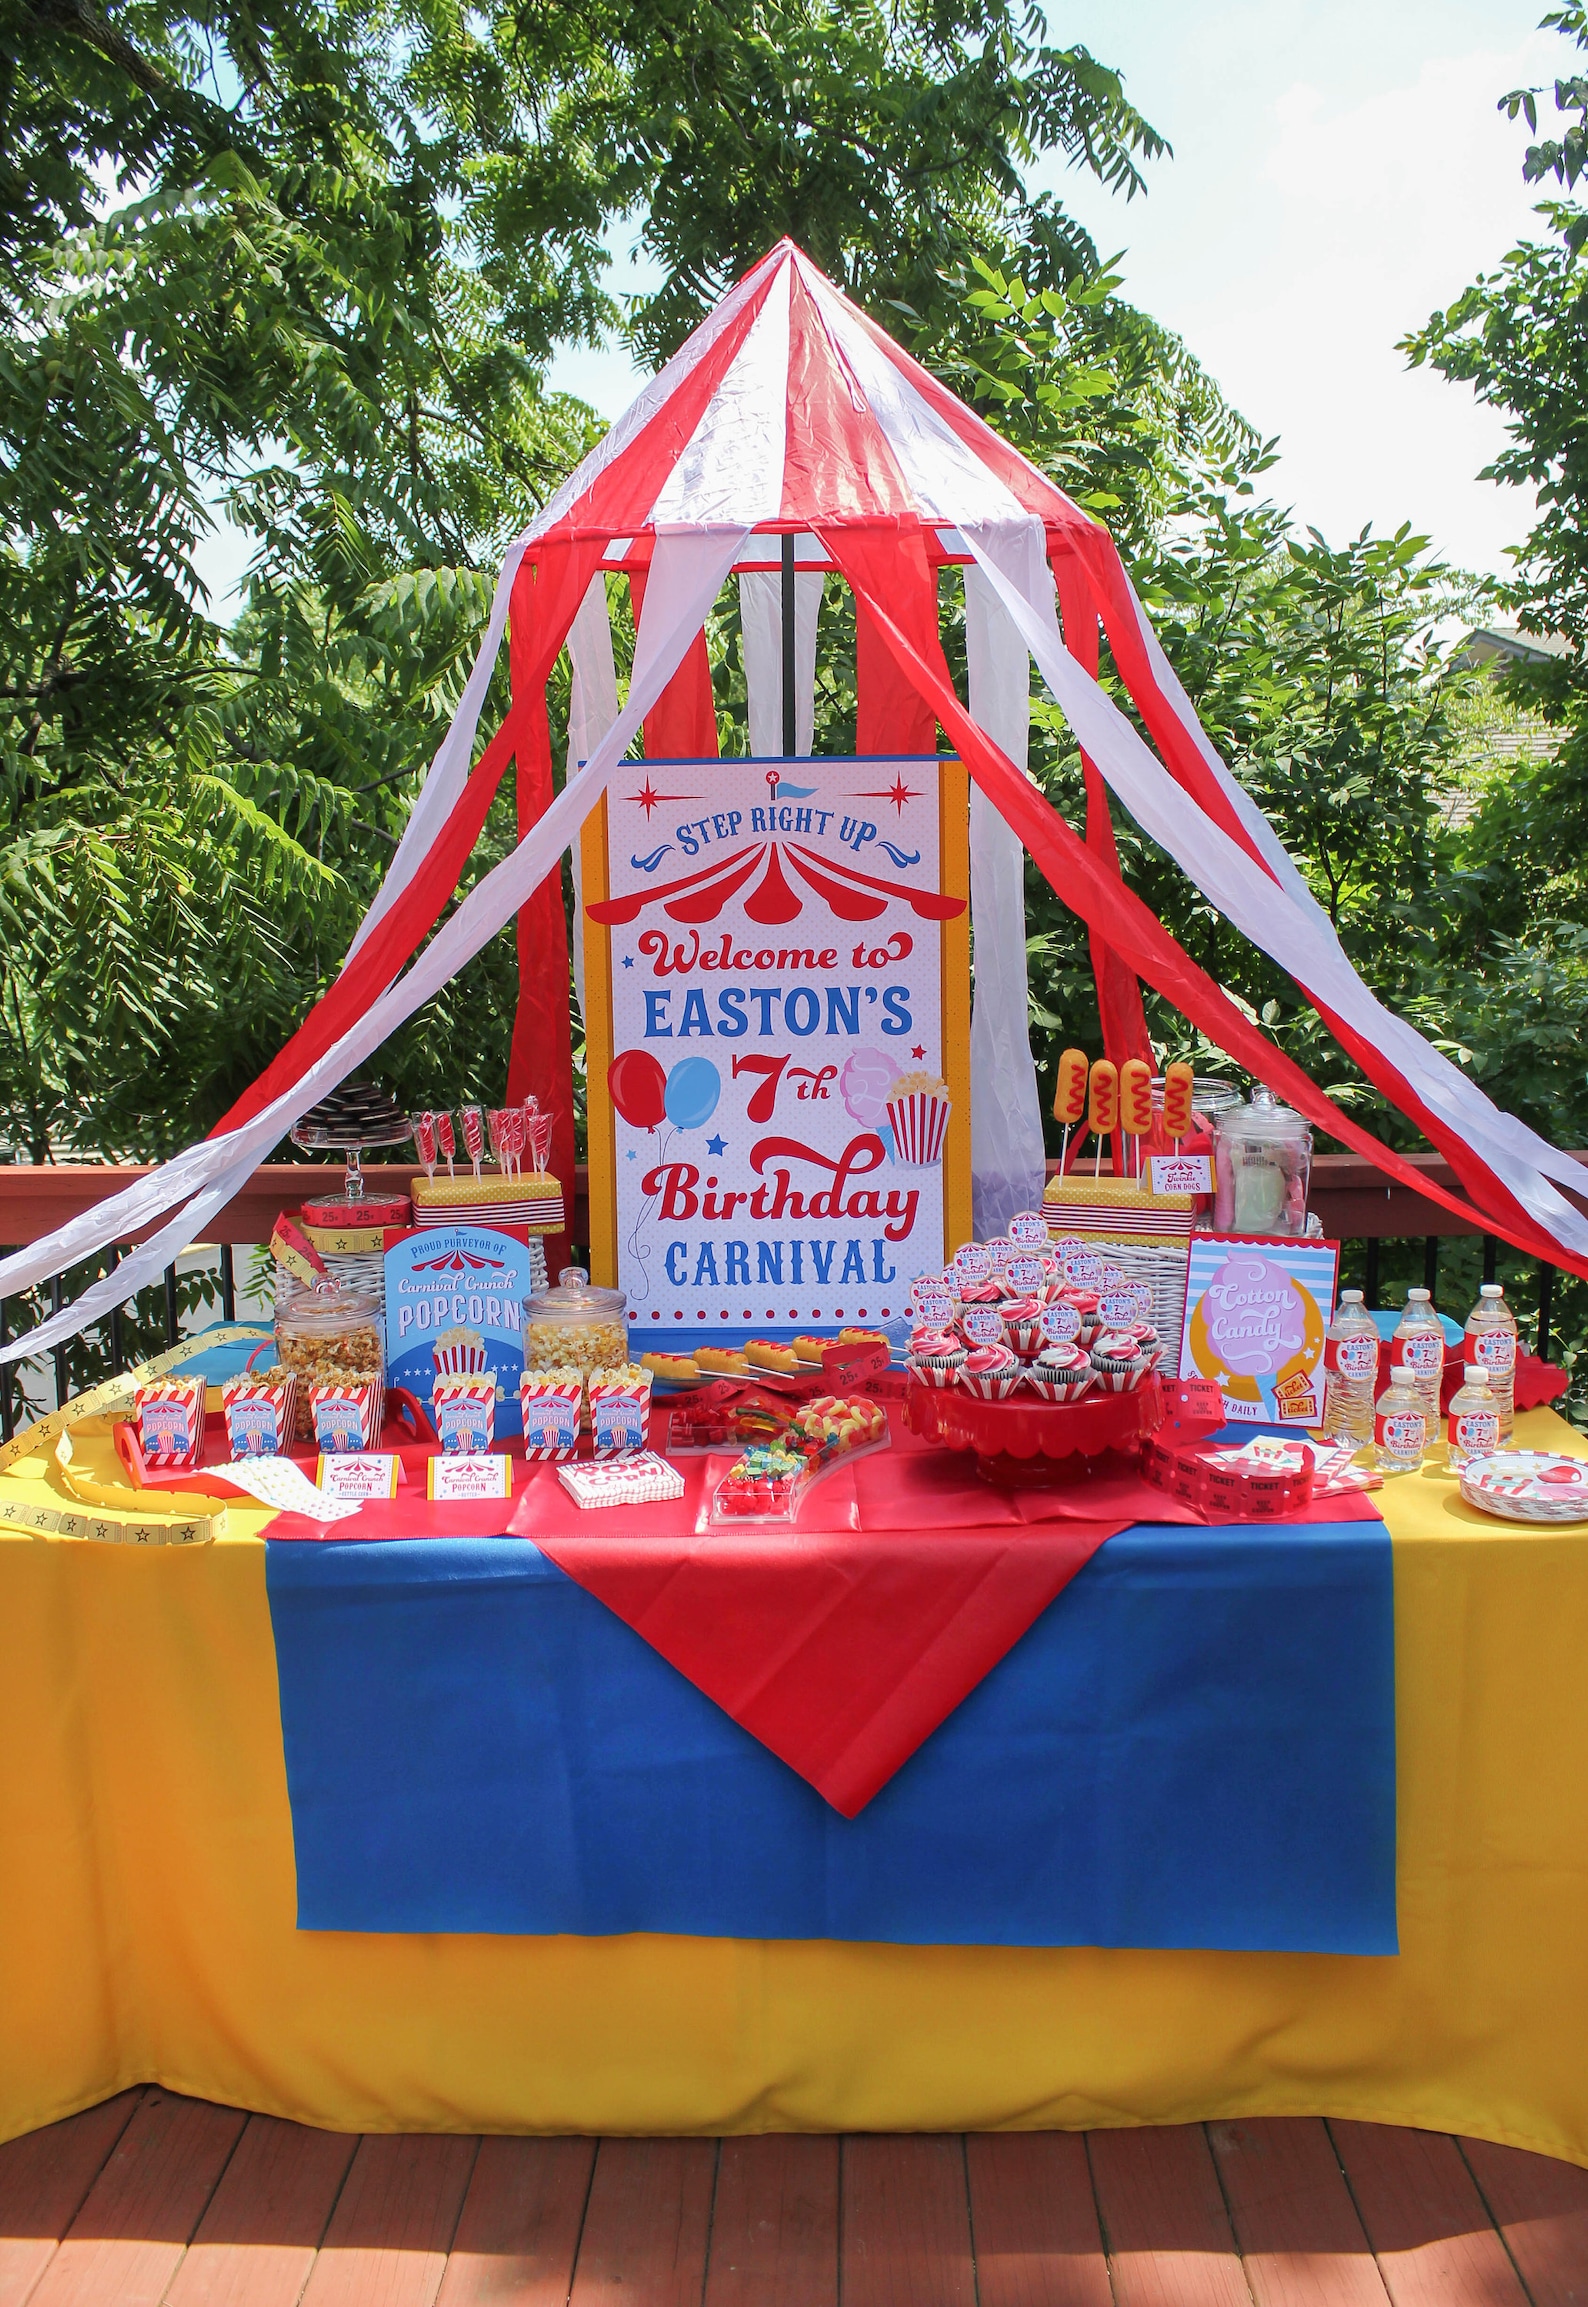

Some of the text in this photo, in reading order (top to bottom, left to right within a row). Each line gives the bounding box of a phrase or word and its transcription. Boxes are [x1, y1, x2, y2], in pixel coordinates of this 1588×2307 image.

[675, 806, 877, 855] STEP RIGHT UP
[638, 929, 914, 977] Welcome to
[642, 986, 913, 1038] EASTON'S
[732, 1053, 838, 1124] 7th
[1167, 1172, 1196, 1182] Twinkie
[641, 1133, 920, 1242] Birthday
[1164, 1182, 1200, 1192] CORN DOGS
[1016, 1235, 1042, 1244] Birthday
[411, 1238, 507, 1258] PROUD PURVEYOR OF
[664, 1239, 896, 1286] CARNIVAL
[961, 1265, 987, 1276] Birthday
[398, 1270, 518, 1293] Carnival Crunch
[1012, 1276, 1040, 1286] Birthday
[1071, 1271, 1098, 1282] Birthday
[1208, 1283, 1297, 1311] Cotton
[398, 1294, 521, 1338] POPCORN
[923, 1312, 950, 1322] Birthday
[1104, 1312, 1131, 1323] Birthday
[971, 1328, 999, 1338] Birthday
[1047, 1325, 1075, 1336] Birthday
[1211, 1305, 1303, 1352] Candy
[1190, 1384, 1214, 1393] TICKET
[1231, 1404, 1258, 1416] DAILY
[1288, 1401, 1308, 1413] ticket
[146, 1421, 184, 1432] POPCORN
[235, 1420, 272, 1430] POPCORN
[321, 1420, 358, 1430] POPCORN
[446, 1419, 483, 1430] POPCORN
[532, 1416, 570, 1427] POPCORN
[600, 1416, 638, 1427] POPCORN
[574, 1459, 648, 1477] POP
[330, 1472, 385, 1482] Carnival Crunch
[442, 1472, 498, 1484] Carnival Crunch
[589, 1468, 657, 1485] CORN
[1178, 1462, 1197, 1476] TICKET
[1209, 1474, 1235, 1487] TICKET
[1251, 1482, 1279, 1490] TICKET
[339, 1482, 372, 1491] POPCORN
[452, 1483, 486, 1492] POPCORN
